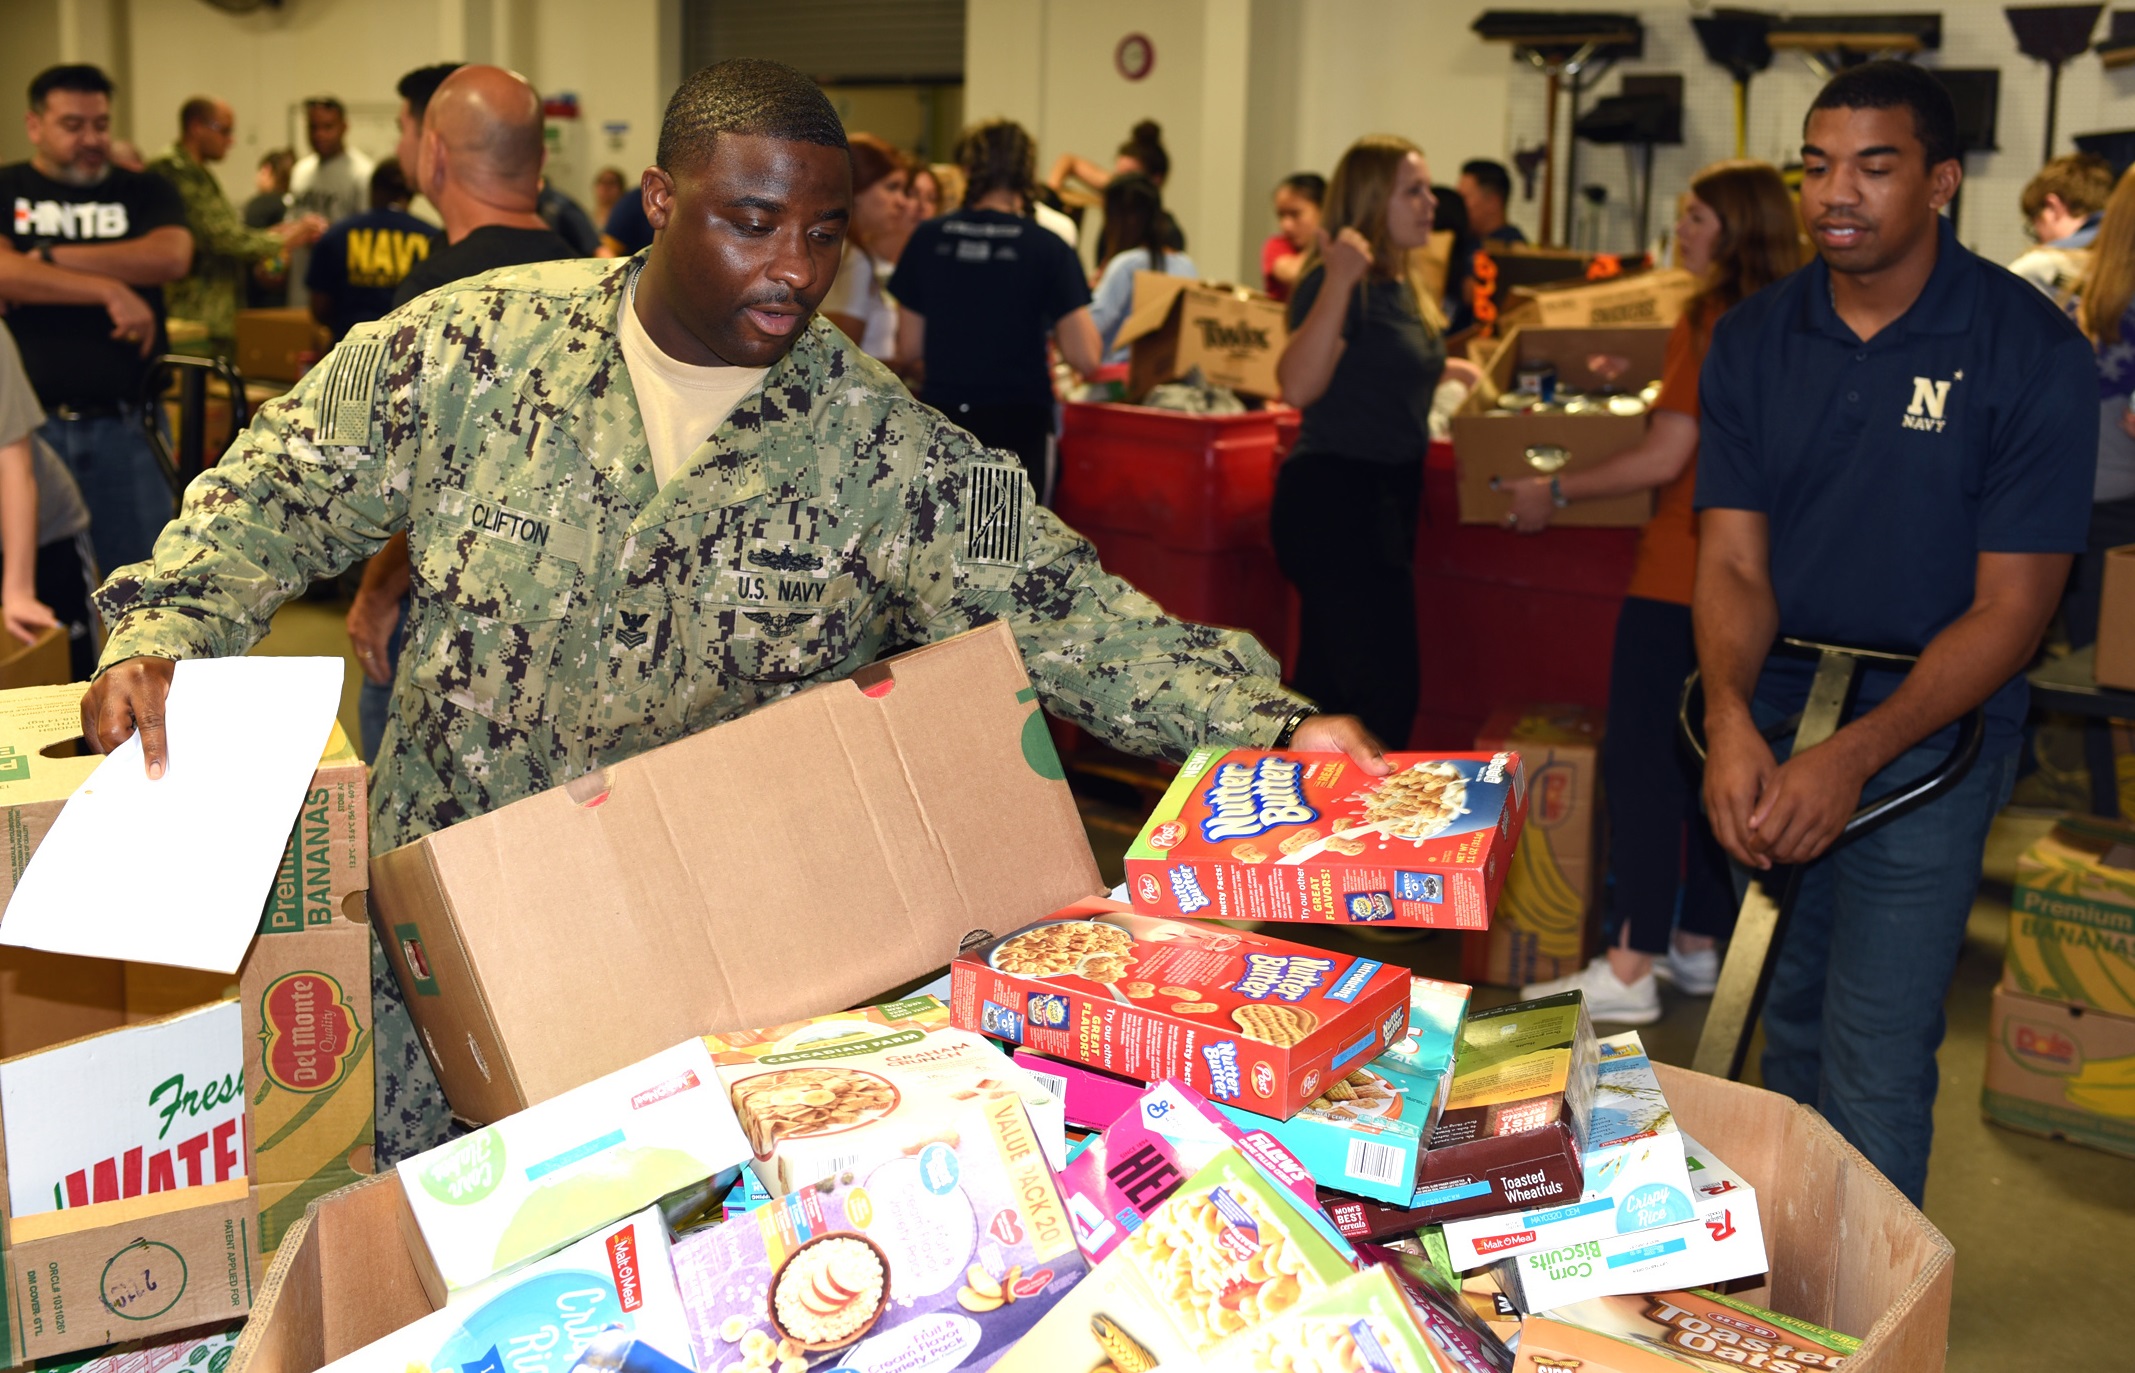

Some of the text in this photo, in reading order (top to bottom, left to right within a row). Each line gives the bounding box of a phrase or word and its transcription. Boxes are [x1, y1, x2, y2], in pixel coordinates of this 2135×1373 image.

[15, 200, 128, 239] HNTB
[1193, 318, 1271, 351] Twix
[1907, 376, 1951, 418] N
[1902, 414, 1946, 433] NAVY
[471, 504, 550, 547] CLIFTON
[738, 578, 827, 602] U.S. NAVY
[1181, 752, 1212, 778] NEW!
[338, 782, 344, 790] AT
[1206, 763, 1263, 840] Nutter
[1251, 758, 1313, 826] Butter
[1151, 824, 1177, 847] Post
[306, 788, 332, 925] BANANAS
[1143, 877, 1157, 899] Post
[1169, 870, 1194, 913] Nutter
[1179, 864, 1209, 907] Butter
[1215, 864, 1228, 916] Nutty Facts!
[1296, 867, 1311, 920] Try our other
[1310, 877, 1322, 911] GREAT
[1321, 869, 1335, 921] FLAVORS!
[1404, 873, 1412, 899] OREO
[2023, 891, 2133, 930] Premium
[1237, 954, 1288, 999] Butter
[1289, 956, 1331, 1000] Nutter
[1333, 962, 1375, 998] Introducing
[292, 979, 317, 1082] Del Monte
[319, 1008, 338, 1053] Quality
[1007, 1011, 1015, 1039] OREO
[1080, 1002, 1091, 1062] FLAVORS!
[1090, 1016, 1101, 1057] GREAT
[1103, 1008, 1115, 1069] Try our other
[766, 1033, 919, 1063] CASCADIAN FARM
[885, 1042, 970, 1062] GRAHAM
[887, 1051, 962, 1067] CRUNCH
[1183, 1030, 1195, 1059] Nutty
[1203, 1047, 1228, 1100] Butter
[1217, 1042, 1239, 1099] Nutter
[1256, 1064, 1273, 1095] Post
[1303, 1072, 1319, 1092] Post
[1502, 1107, 1547, 1122] cereals
[1503, 1113, 1546, 1129] BEST
[65, 1114, 248, 1208] WATE
[1119, 1147, 1135, 1159] SINCE
[1255, 1152, 1276, 1171] FILLED
[448, 1160, 492, 1199] Corn
[995, 1104, 1030, 1162] VALUE
[1035, 1216, 1061, 1242] 20
[1501, 1169, 1546, 1191] Toasted
[1335, 1205, 1361, 1215] MOM'S
[1505, 1182, 1563, 1204] Wheatfuls
[1626, 1186, 1670, 1212] Crispy
[1337, 1212, 1363, 1224] BEST
[1340, 1222, 1366, 1231] cereals
[1637, 1208, 1666, 1227] Rice
[614, 1240, 628, 1269] Malt
[1483, 1238, 1503, 1250] Malt
[1511, 1233, 1534, 1244] Meal
[1530, 1241, 1602, 1271] Biscuits
[224, 1218, 240, 1306] PATENT APPLIED FOR
[1550, 1262, 1592, 1281] Corn
[27, 1271, 38, 1284] DM
[33, 1318, 43, 1336] GTL
[48, 1262, 66, 1334] ORCL# 10310261
[620, 1276, 640, 1309] Meal
[913, 1319, 955, 1344] Fruit &
[1716, 1315, 1771, 1336] H-E-B
[1722, 1297, 1760, 1313] GRAMS
[1763, 1310, 1777, 1318] OF
[1780, 1316, 1826, 1336] WHOLE
[868, 1346, 916, 1373] Cream
[918, 1328, 959, 1352] Flavor
[884, 1354, 927, 1373] ariety
[930, 1336, 963, 1356] Pack
[1433, 1313, 1481, 1364] FILLED
[1679, 1332, 1801, 1373] Oats
